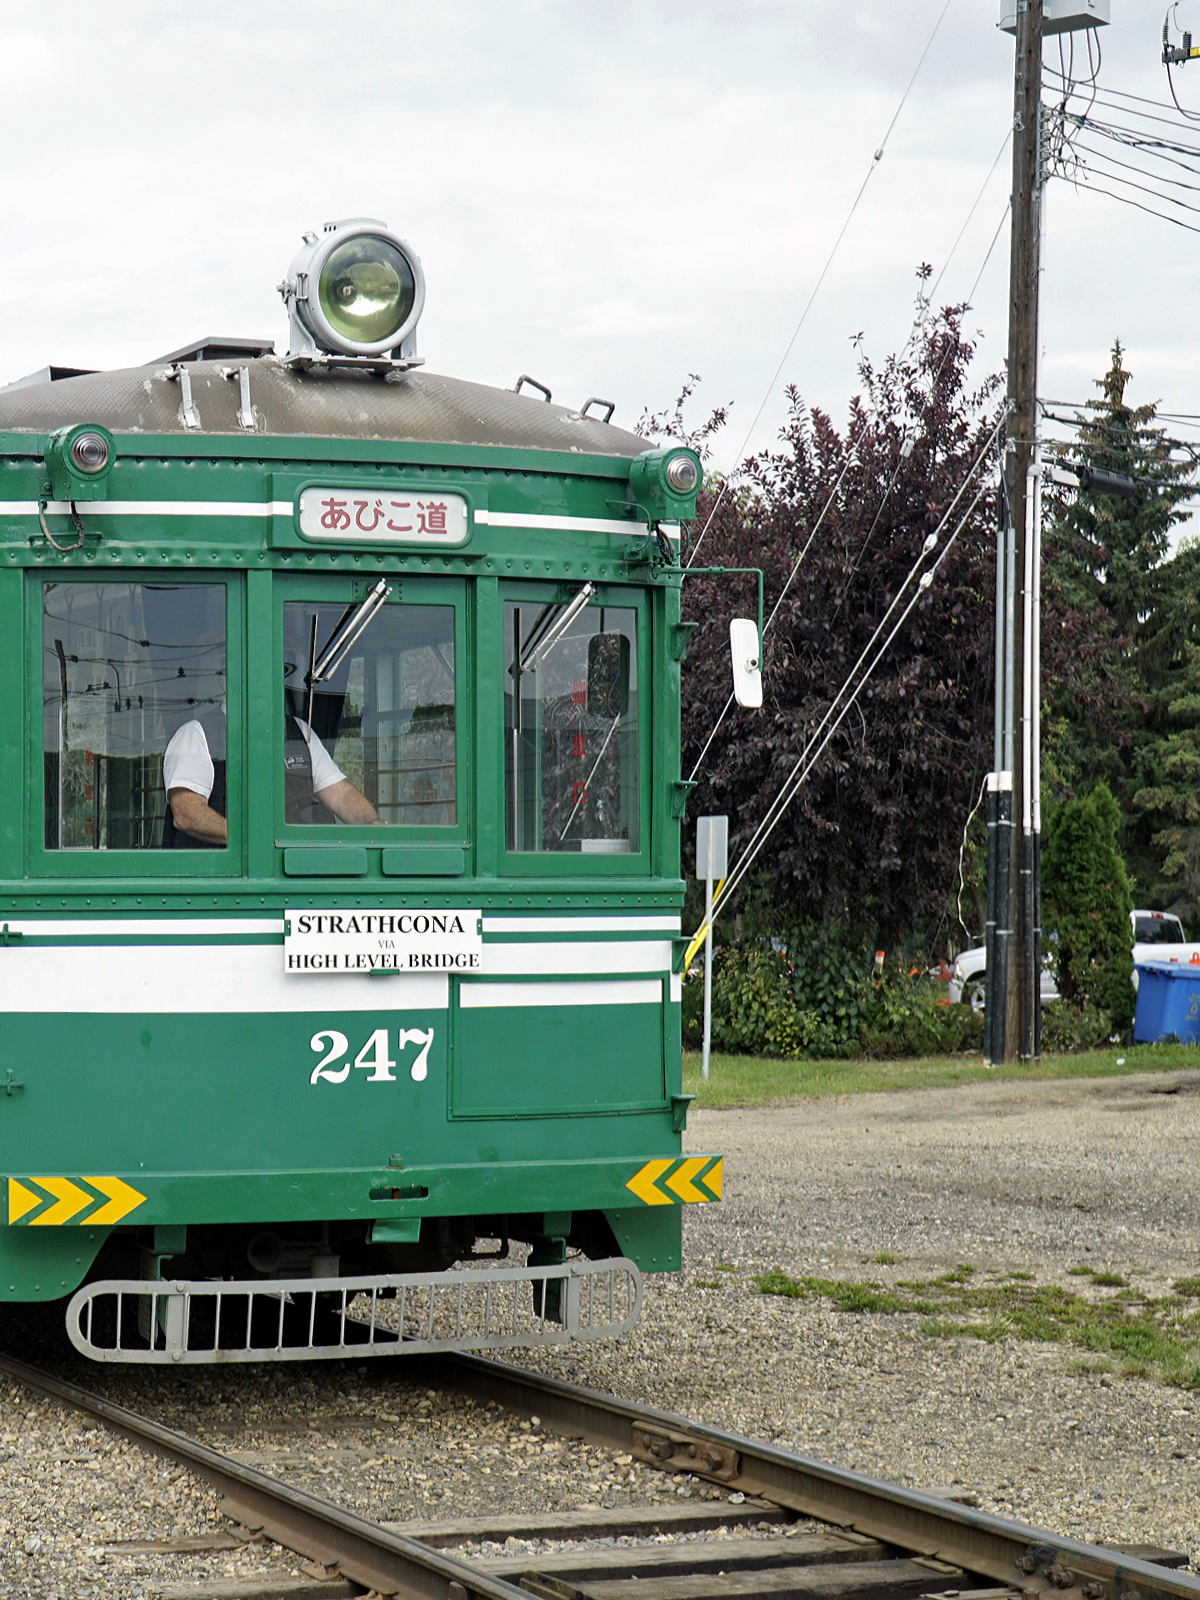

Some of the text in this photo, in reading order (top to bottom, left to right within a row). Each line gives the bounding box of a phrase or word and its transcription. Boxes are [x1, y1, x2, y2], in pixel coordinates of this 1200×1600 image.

[320, 497, 448, 535] あびこ道
[297, 915, 465, 934] STRATHCONA
[377, 940, 396, 949] VIA
[288, 953, 480, 969] HIGH LEVEL BRIDGE
[310, 1028, 435, 1085] 247
